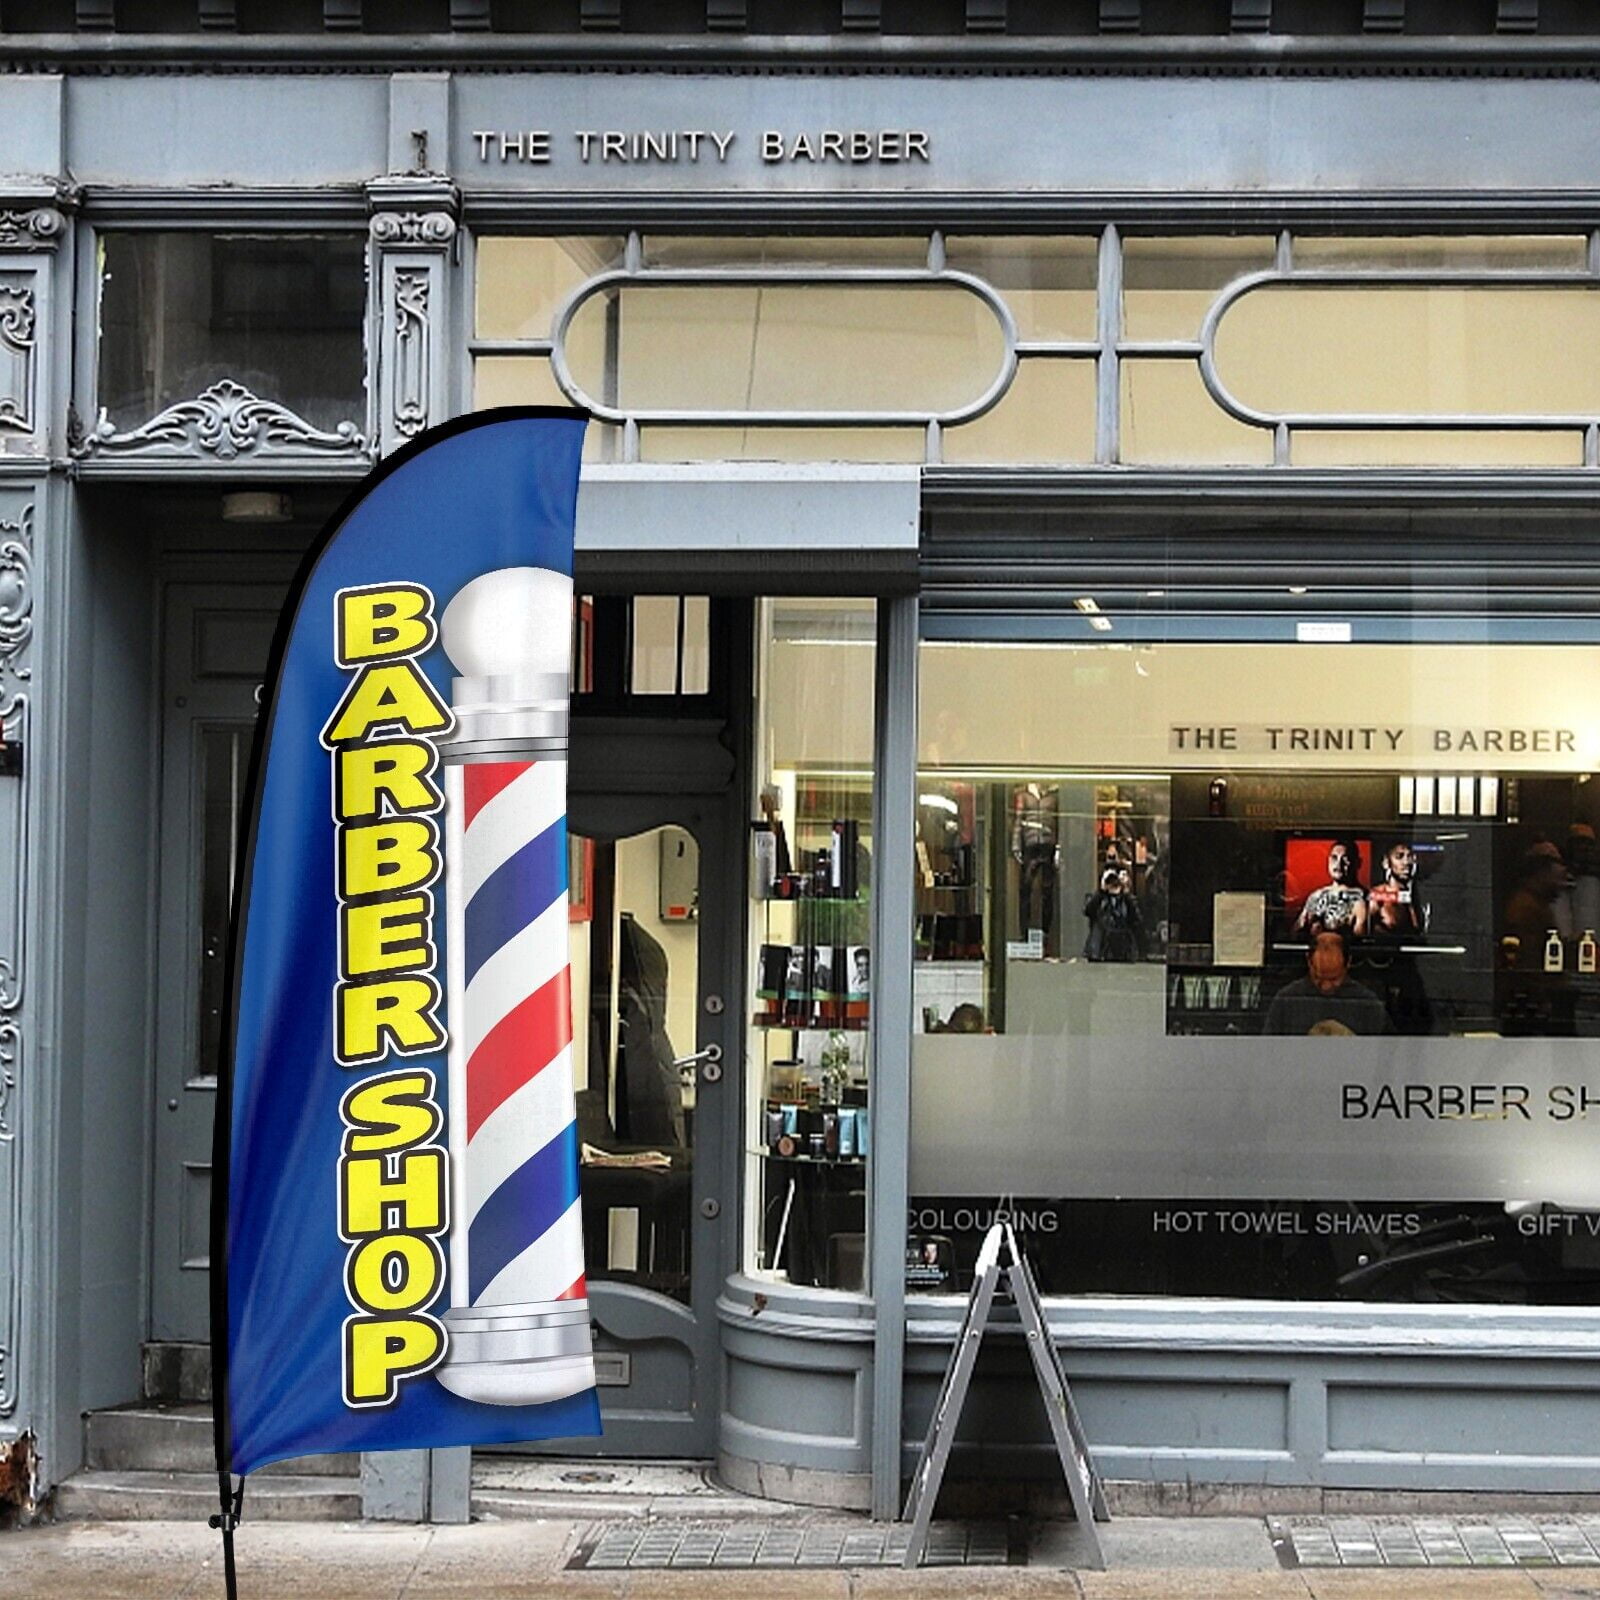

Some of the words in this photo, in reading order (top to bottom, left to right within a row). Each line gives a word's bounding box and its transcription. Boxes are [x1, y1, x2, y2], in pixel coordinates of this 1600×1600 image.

[473, 130, 551, 162] THE
[575, 130, 735, 162] TRINITY
[761, 130, 931, 162] BARBER
[1172, 727, 1238, 750] THE
[1266, 728, 1404, 751] TRINITY
[1433, 729, 1577, 753] BARBER
[319, 581, 456, 1066] BARBER
[1341, 1084, 1531, 1121] BARBER
[337, 1068, 449, 1408] SHOP
[1153, 1211, 1208, 1232] HOT
[1215, 1211, 1308, 1234] TOWEL
[1315, 1212, 1421, 1235] SHAVES
[1518, 1213, 1579, 1236] GIFT
